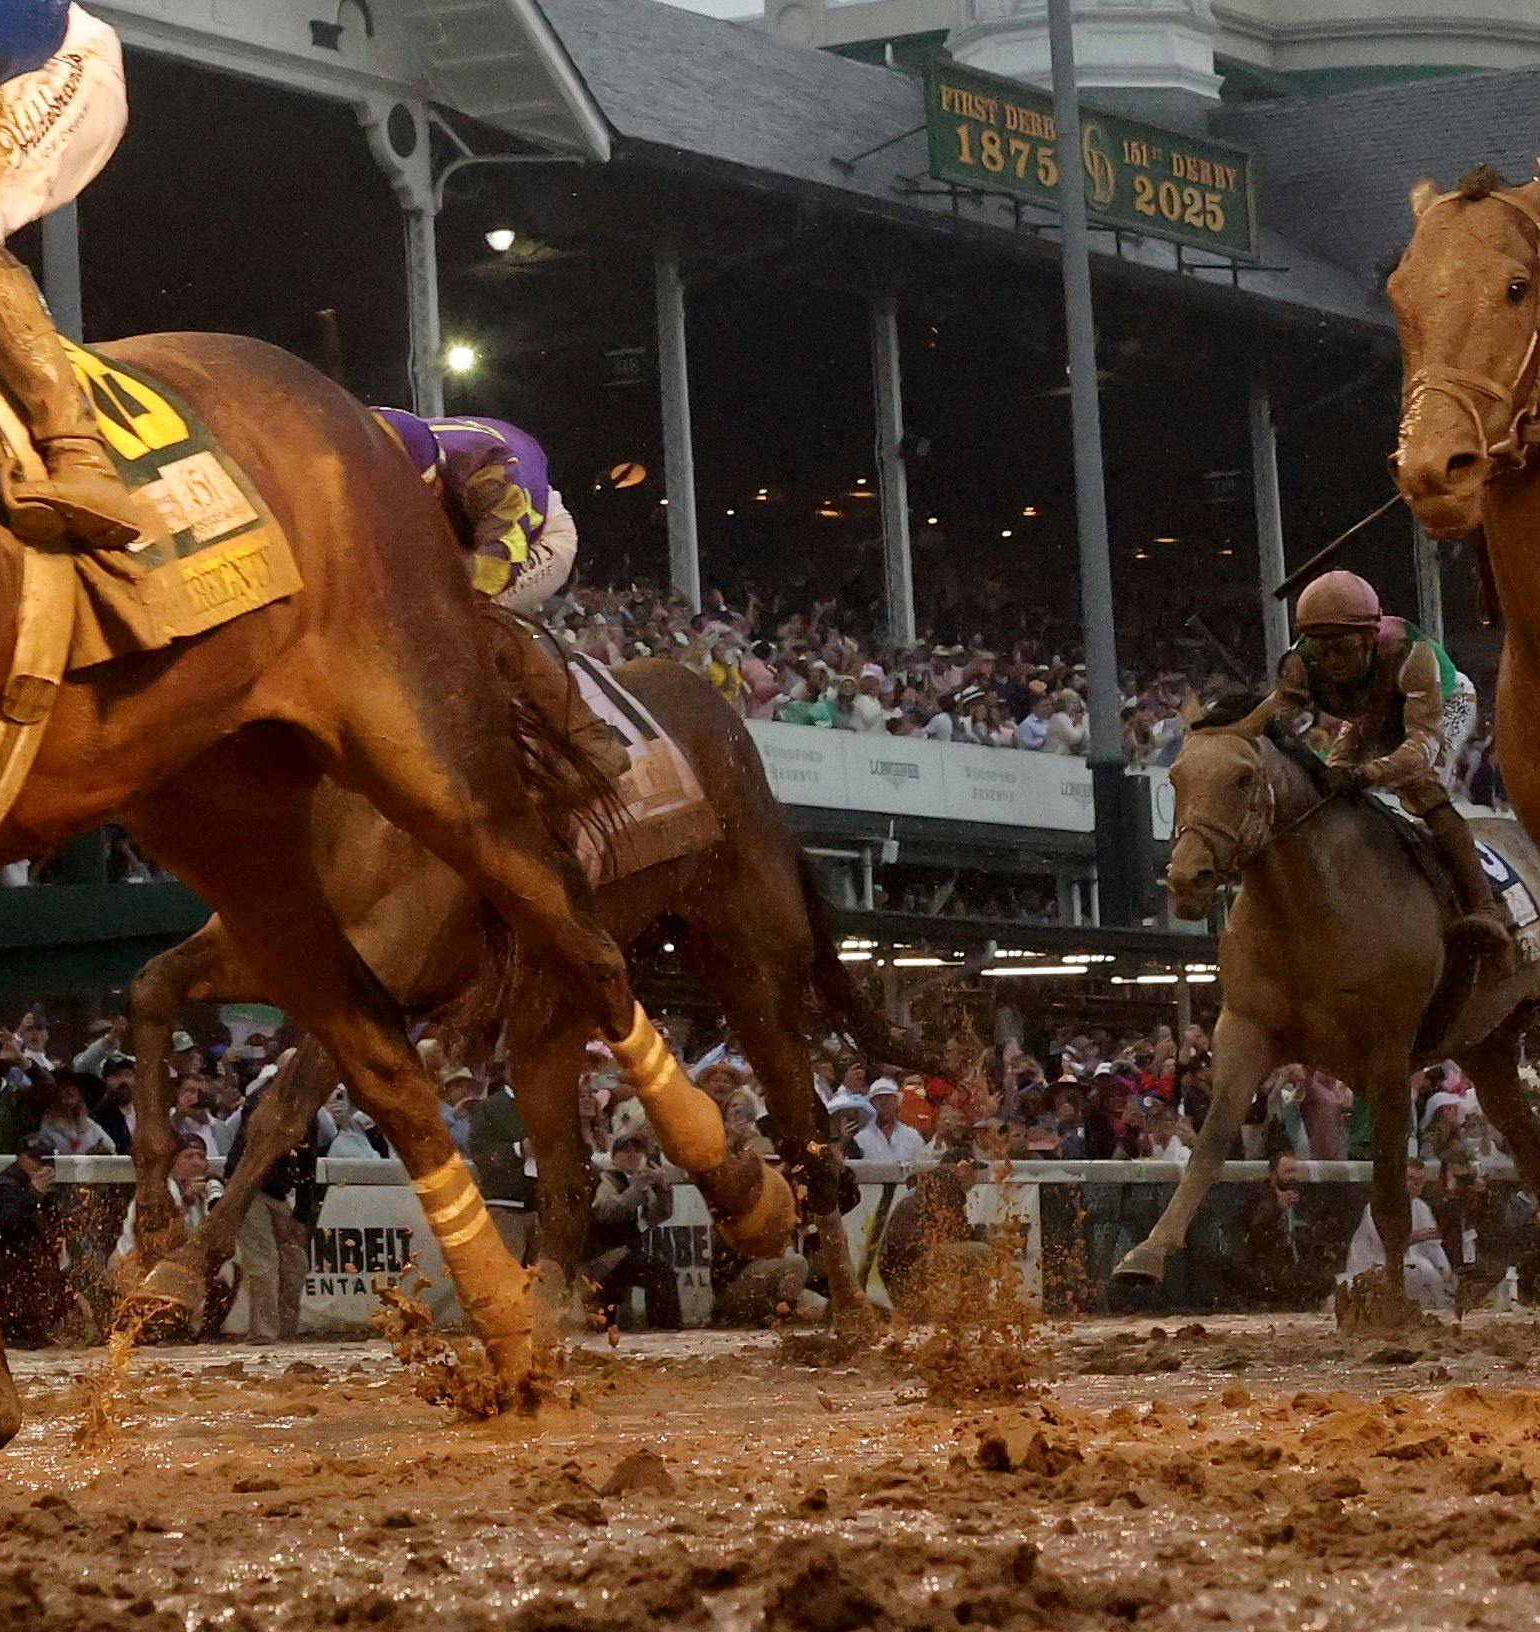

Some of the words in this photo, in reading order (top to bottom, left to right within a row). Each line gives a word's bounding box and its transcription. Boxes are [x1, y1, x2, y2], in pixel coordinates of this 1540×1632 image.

[940, 85, 998, 126] FIRST
[1004, 103, 1057, 142] DERB
[956, 124, 1060, 187] 1875
[1171, 151, 1237, 193] DERBY
[1133, 175, 1225, 232] 2025
[310, 1227, 414, 1274] NBELT
